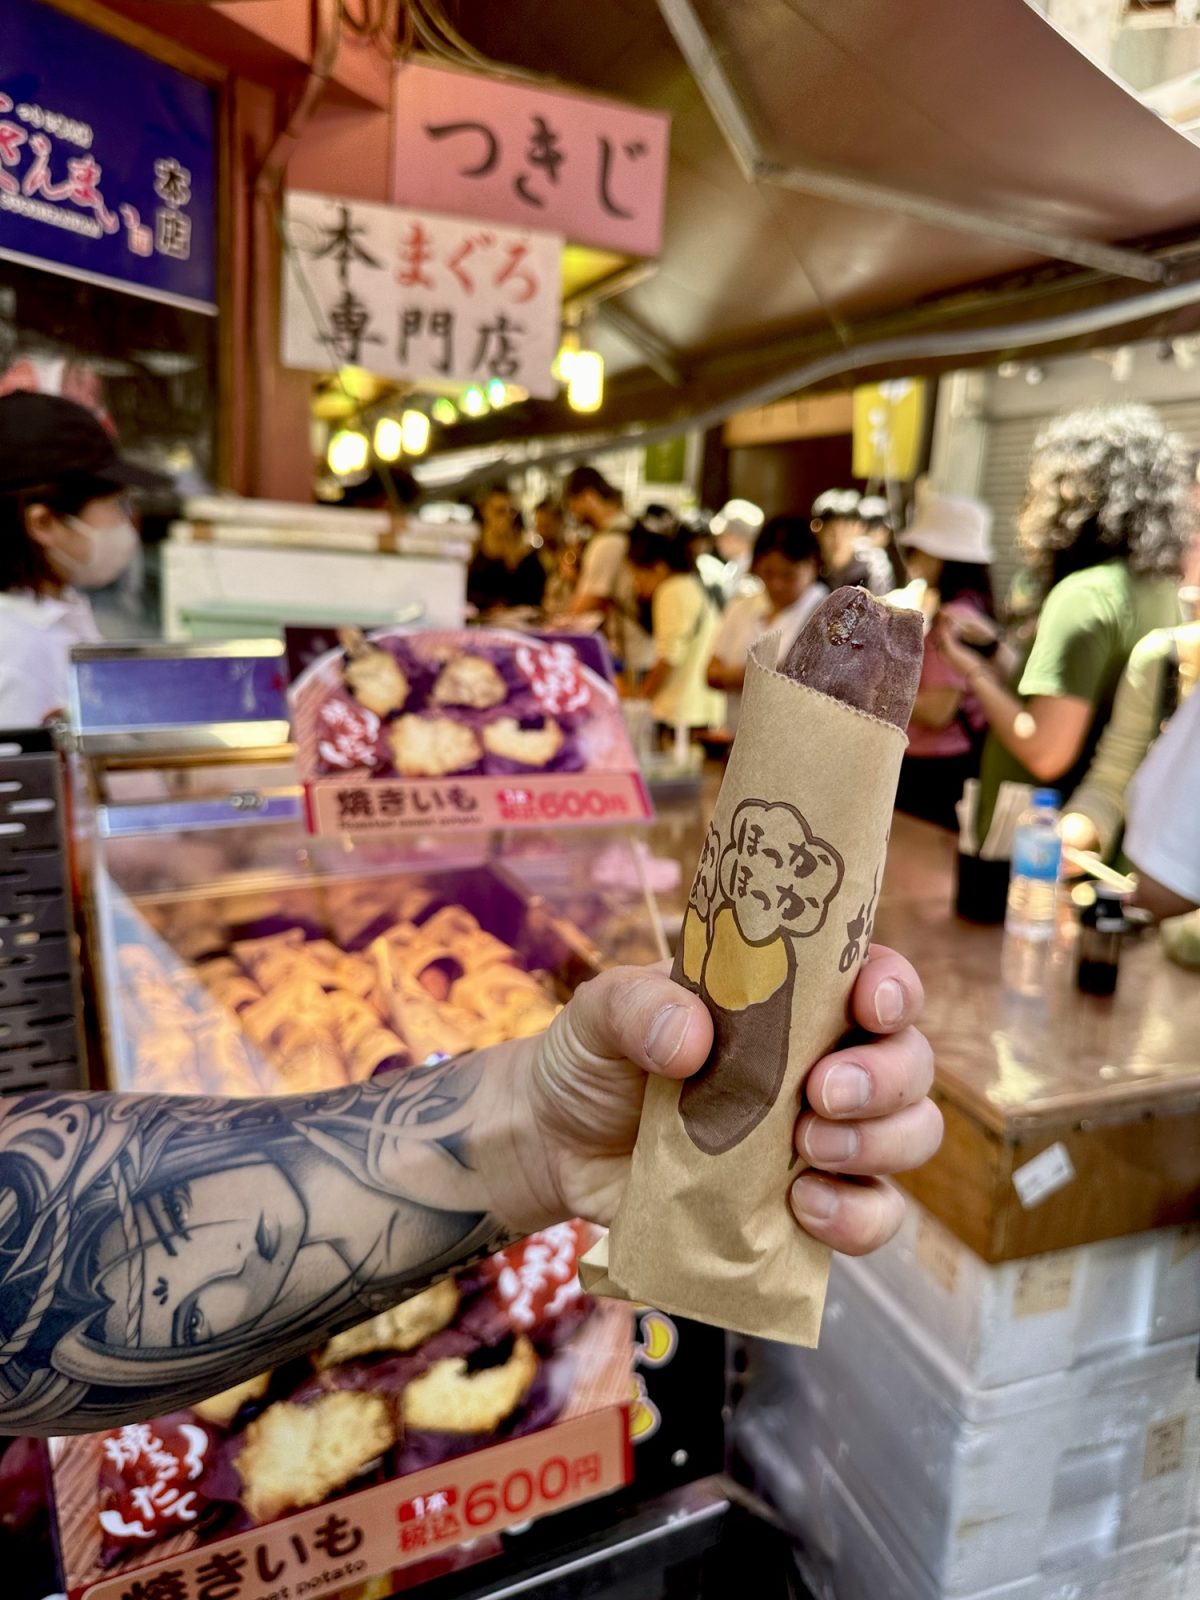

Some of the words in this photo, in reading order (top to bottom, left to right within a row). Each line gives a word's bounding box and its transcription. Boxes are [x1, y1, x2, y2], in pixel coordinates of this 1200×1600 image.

[422, 112, 649, 221] つきじ
[153, 156, 192, 261] 本店
[312, 206, 540, 304] 本まぐろ
[314, 291, 529, 379] 専門店
[336, 786, 478, 817] 焼きいも
[737, 817, 832, 879] ほっか
[729, 858, 820, 921] ほっか
[411, 1491, 449, 1520] 1本
[463, 1452, 602, 1527] 600円
[296, 1560, 367, 1595] potato
